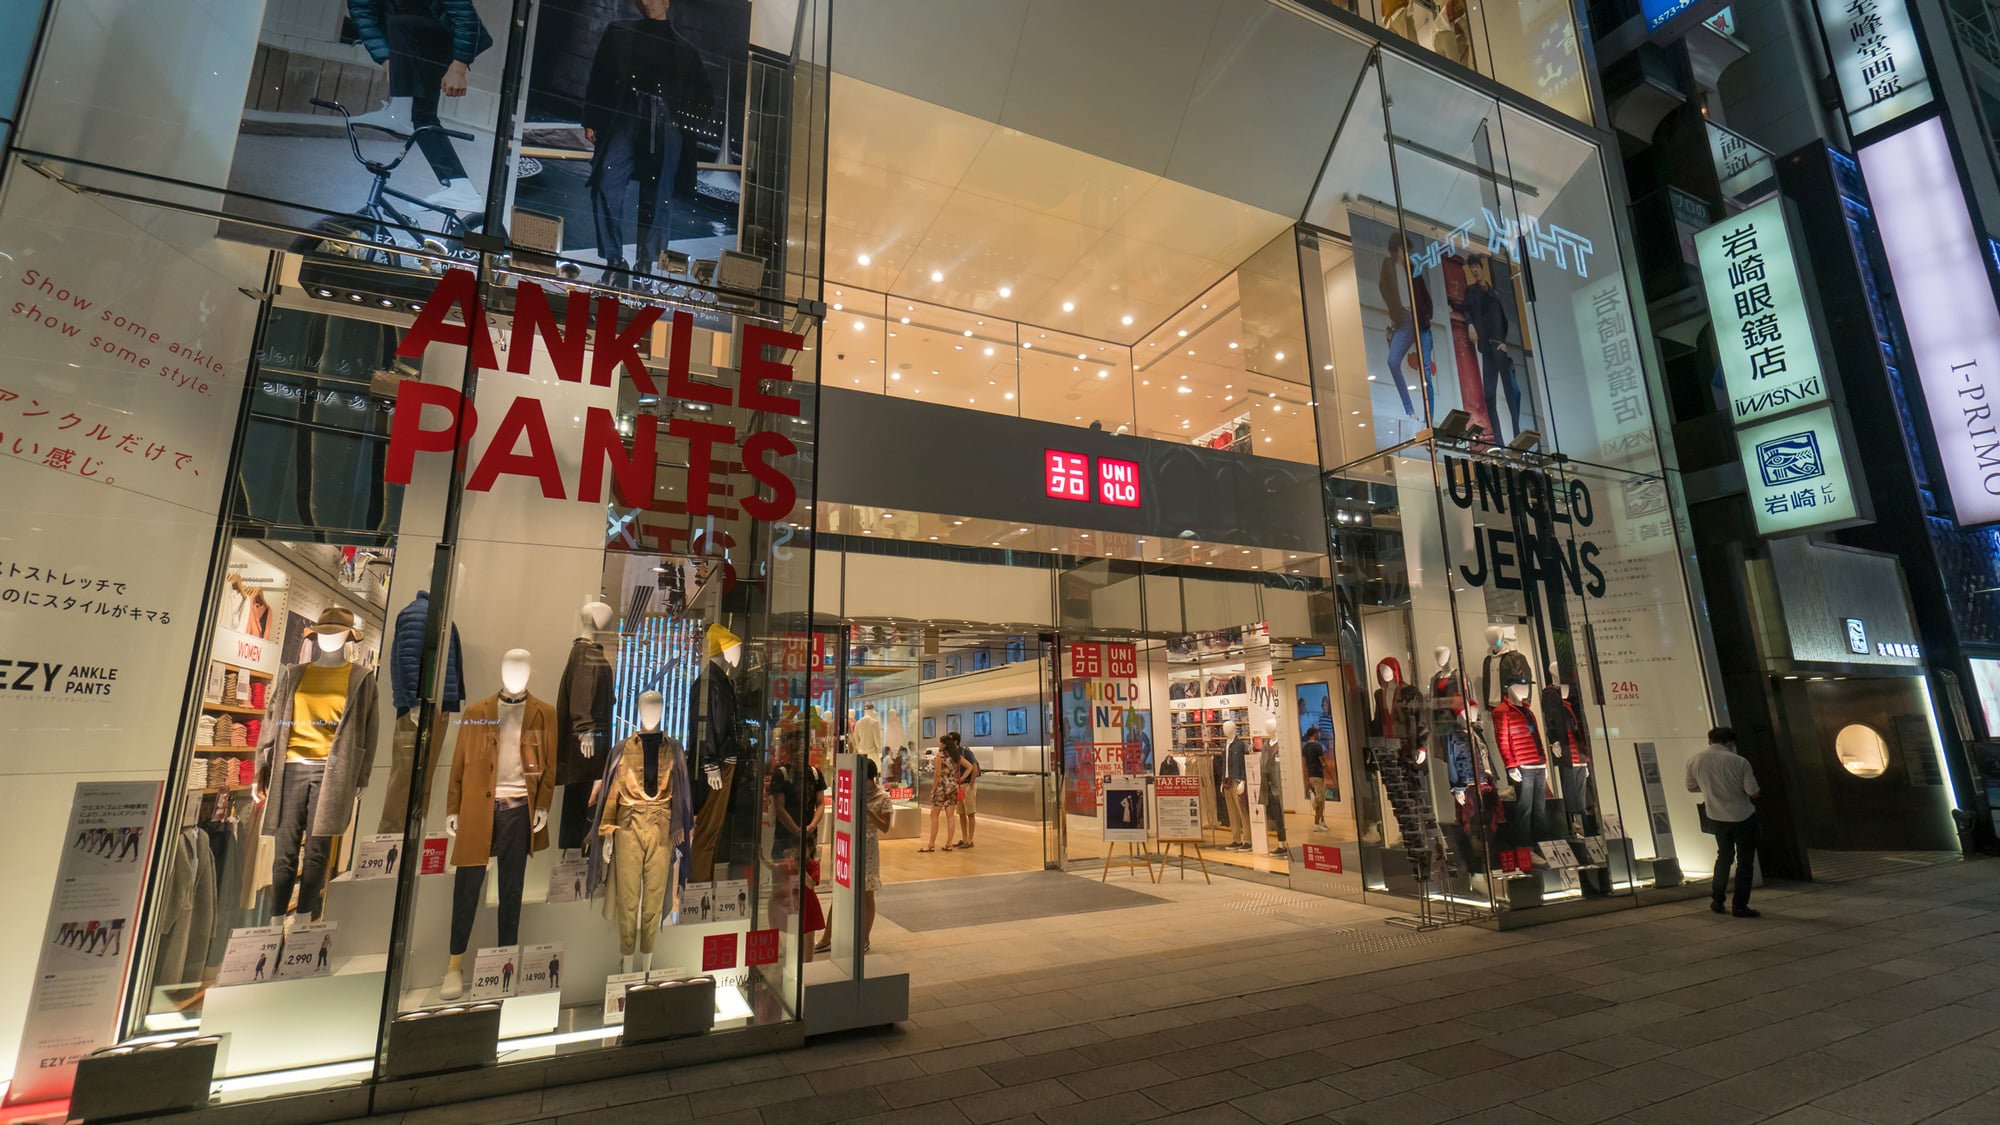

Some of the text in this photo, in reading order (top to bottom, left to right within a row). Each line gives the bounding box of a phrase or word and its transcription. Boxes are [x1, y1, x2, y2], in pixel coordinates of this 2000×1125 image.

[1722, 223, 1787, 381] 岩崎眼鏡店
[21, 269, 226, 377] Show some ankle.
[11, 300, 212, 397] show some style.
[395, 269, 804, 417] ANKLE
[0, 432, 115, 485] い感じ。
[384, 380, 798, 522] PANTS
[1051, 455, 1083, 476] ユニ
[1102, 463, 1132, 483] UNI
[1051, 475, 1084, 495] クロ
[1103, 482, 1135, 502] QLO
[1444, 455, 1594, 527] UNIQLO
[1764, 487, 1816, 515] 岩崎
[1459, 526, 1606, 598] JEANS
[2, 588, 171, 624] のにスタイルがキマる
[237, 640, 262, 663] WOMEN
[1111, 648, 1132, 660] UNI
[0, 659, 118, 691] EZY ANKLE
[1111, 663, 1134, 675] QLO
[65, 681, 111, 695] PANTS
[1072, 682, 1138, 703] UNIQLO
[1611, 681, 1639, 693] 24h
[1073, 706, 1138, 728] GINZA
[1076, 747, 1142, 762] TAX FREE
[1157, 777, 1198, 786] TAX FREE
[837, 838, 848, 858] UNI
[836, 859, 849, 880] QLO
[40, 1056, 66, 1068] EZY
